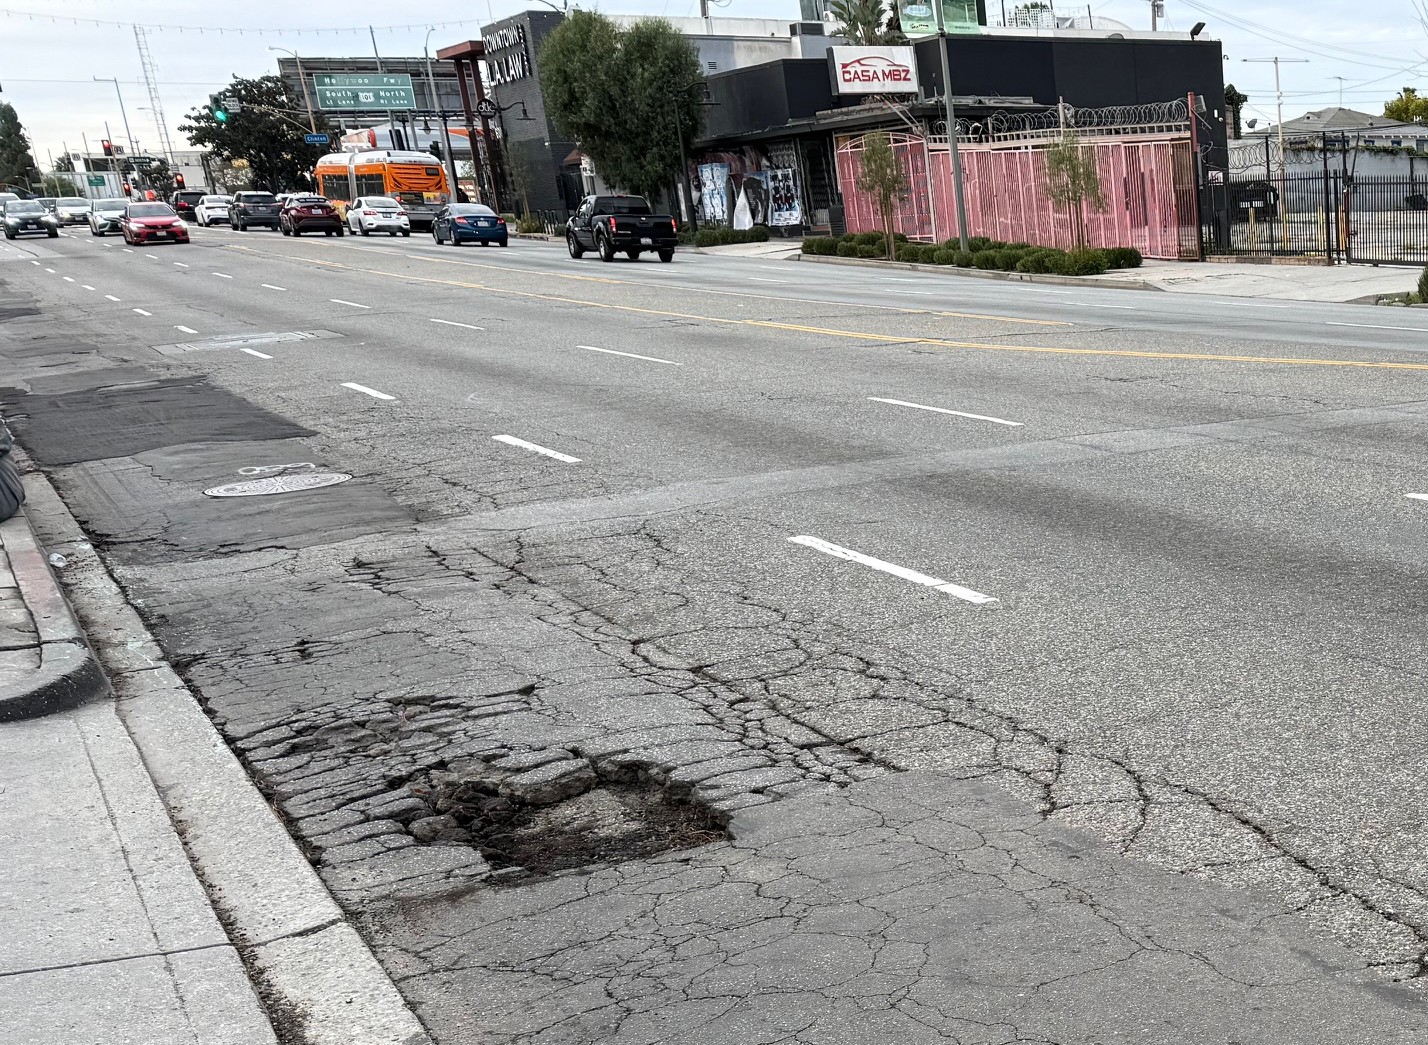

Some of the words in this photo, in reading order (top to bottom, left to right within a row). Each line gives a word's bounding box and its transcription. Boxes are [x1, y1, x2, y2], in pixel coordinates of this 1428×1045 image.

[482, 24, 520, 54] DOWNTOWN
[502, 52, 523, 82] LAW
[842, 70, 881, 82] CASA
[882, 69, 912, 82] MBZ
